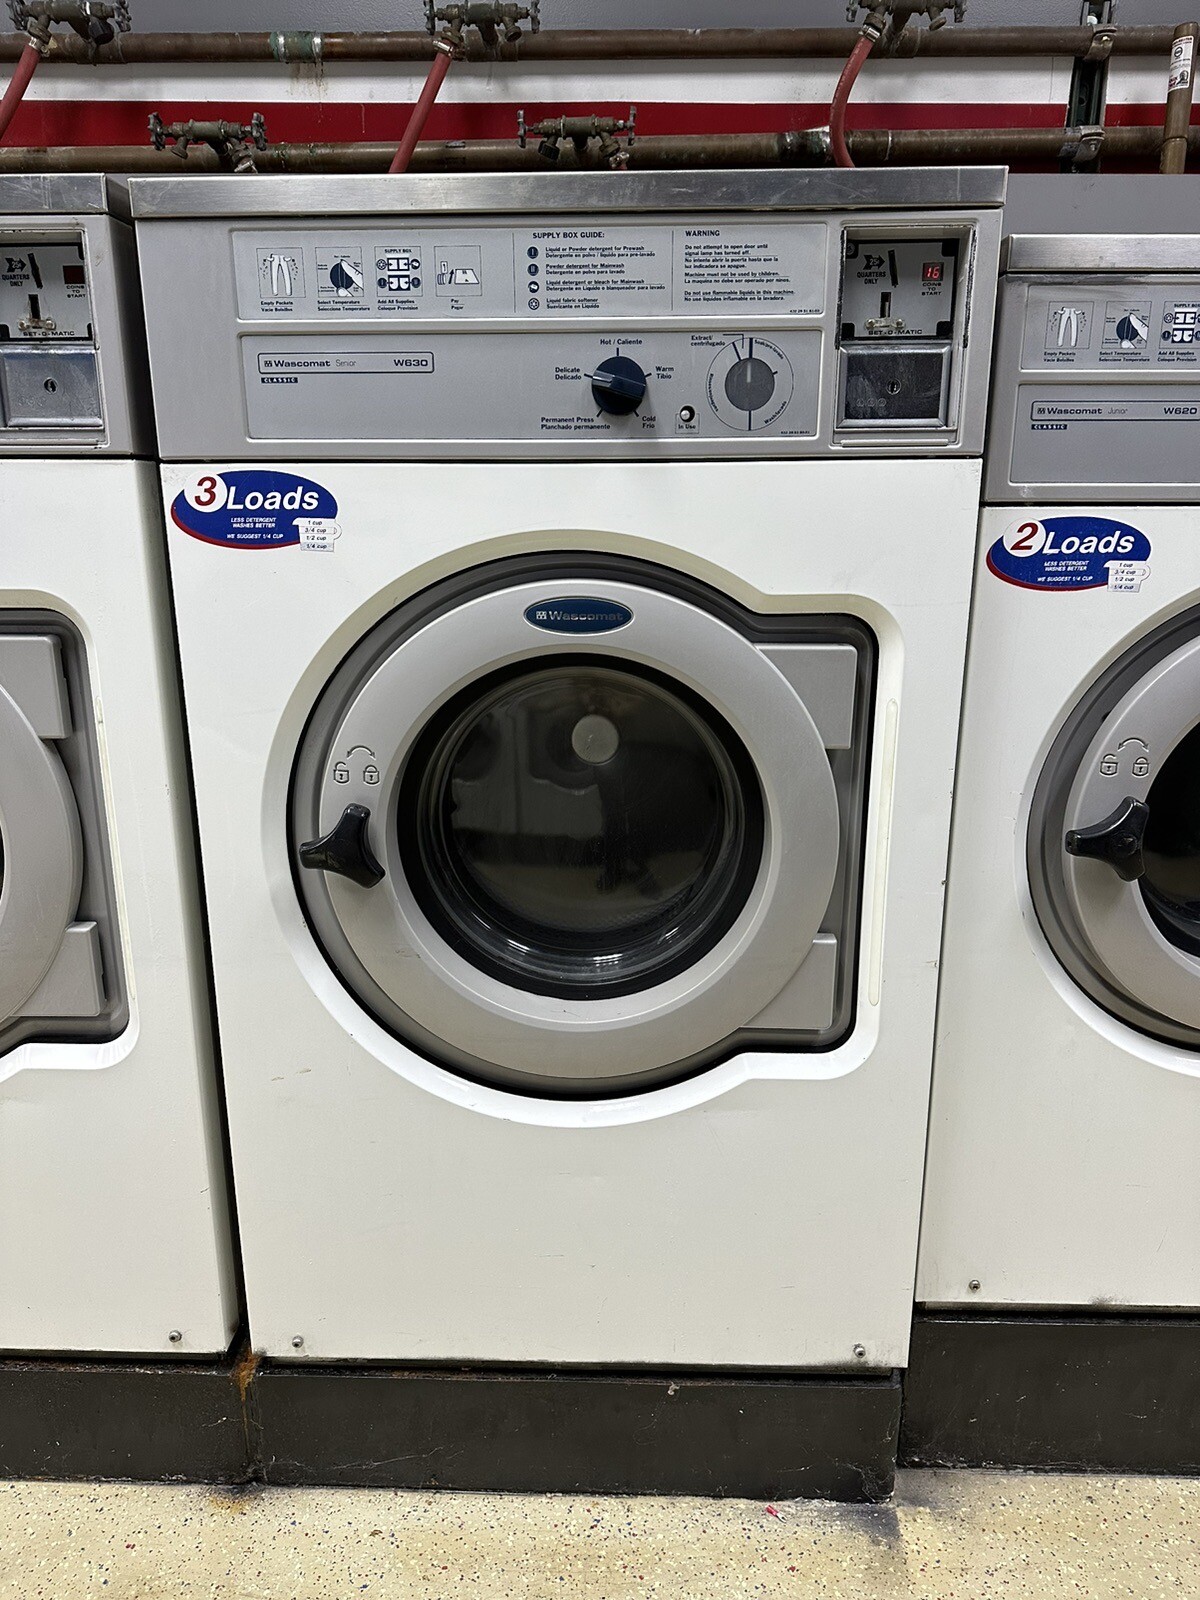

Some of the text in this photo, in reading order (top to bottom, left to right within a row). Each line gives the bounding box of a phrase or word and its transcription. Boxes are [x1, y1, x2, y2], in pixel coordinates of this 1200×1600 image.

[927, 267, 940, 278] 16
[335, 359, 356, 367] Senior
[1108, 407, 1128, 415] Junior
[194, 476, 319, 510] 3 Loads
[1010, 522, 1135, 554] 2 Loads
[549, 611, 623, 621] Wascomat
